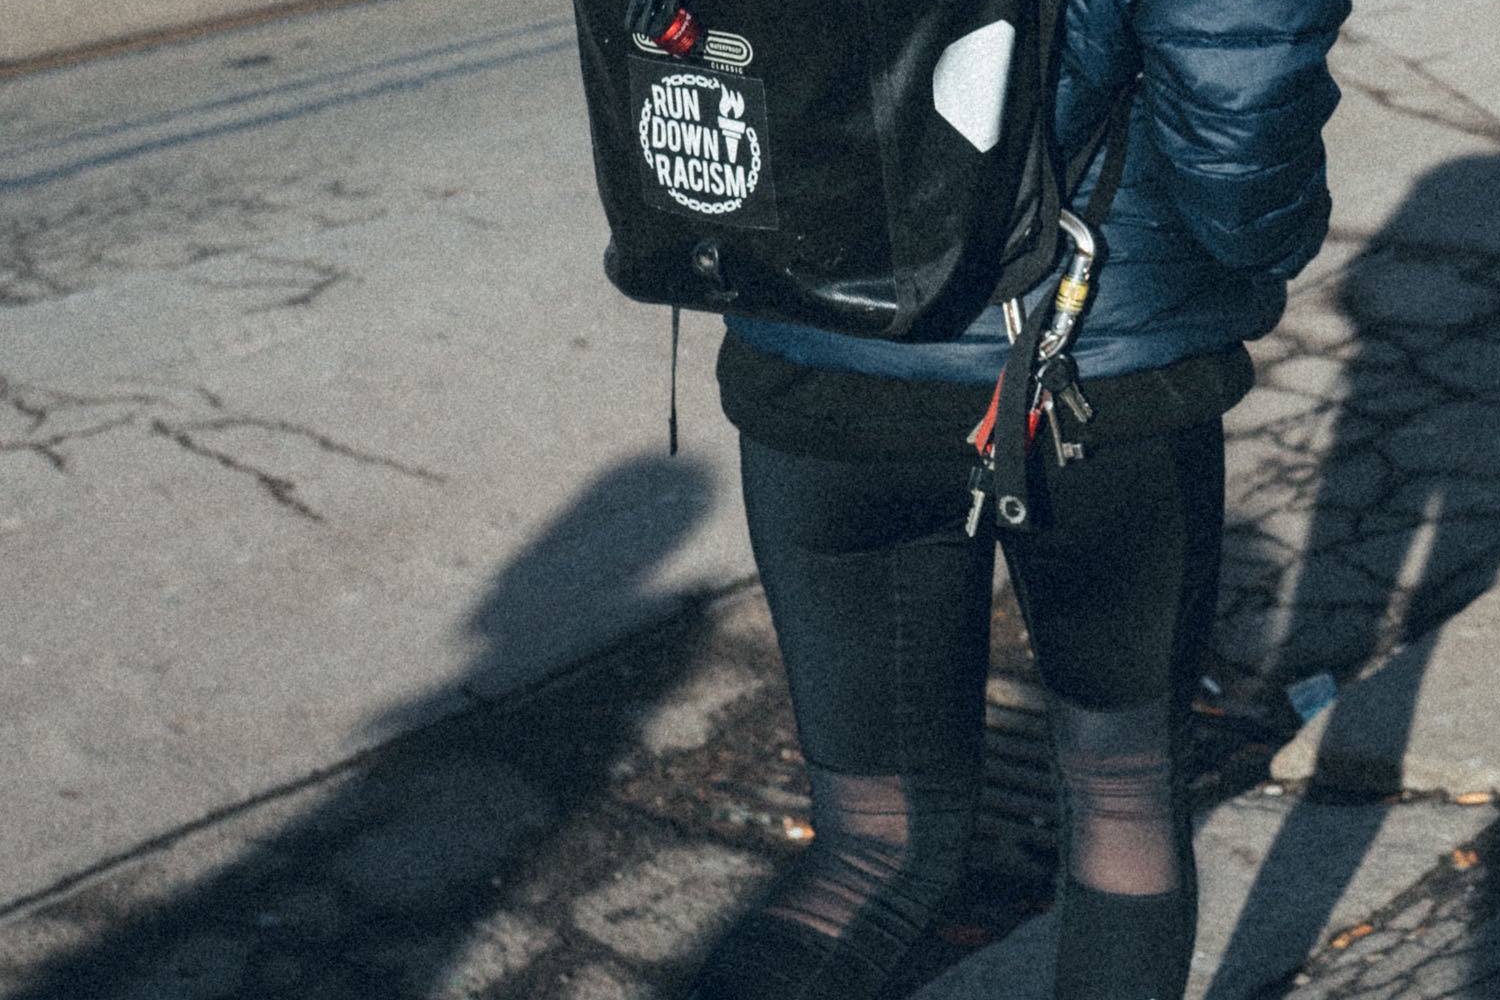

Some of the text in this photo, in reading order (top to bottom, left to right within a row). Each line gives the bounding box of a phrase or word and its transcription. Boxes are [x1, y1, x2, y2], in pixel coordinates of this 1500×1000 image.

[711, 62, 743, 74] CLASSIC
[651, 84, 700, 122] RUN
[652, 116, 719, 161] DOWN
[655, 154, 747, 198] RACISM
